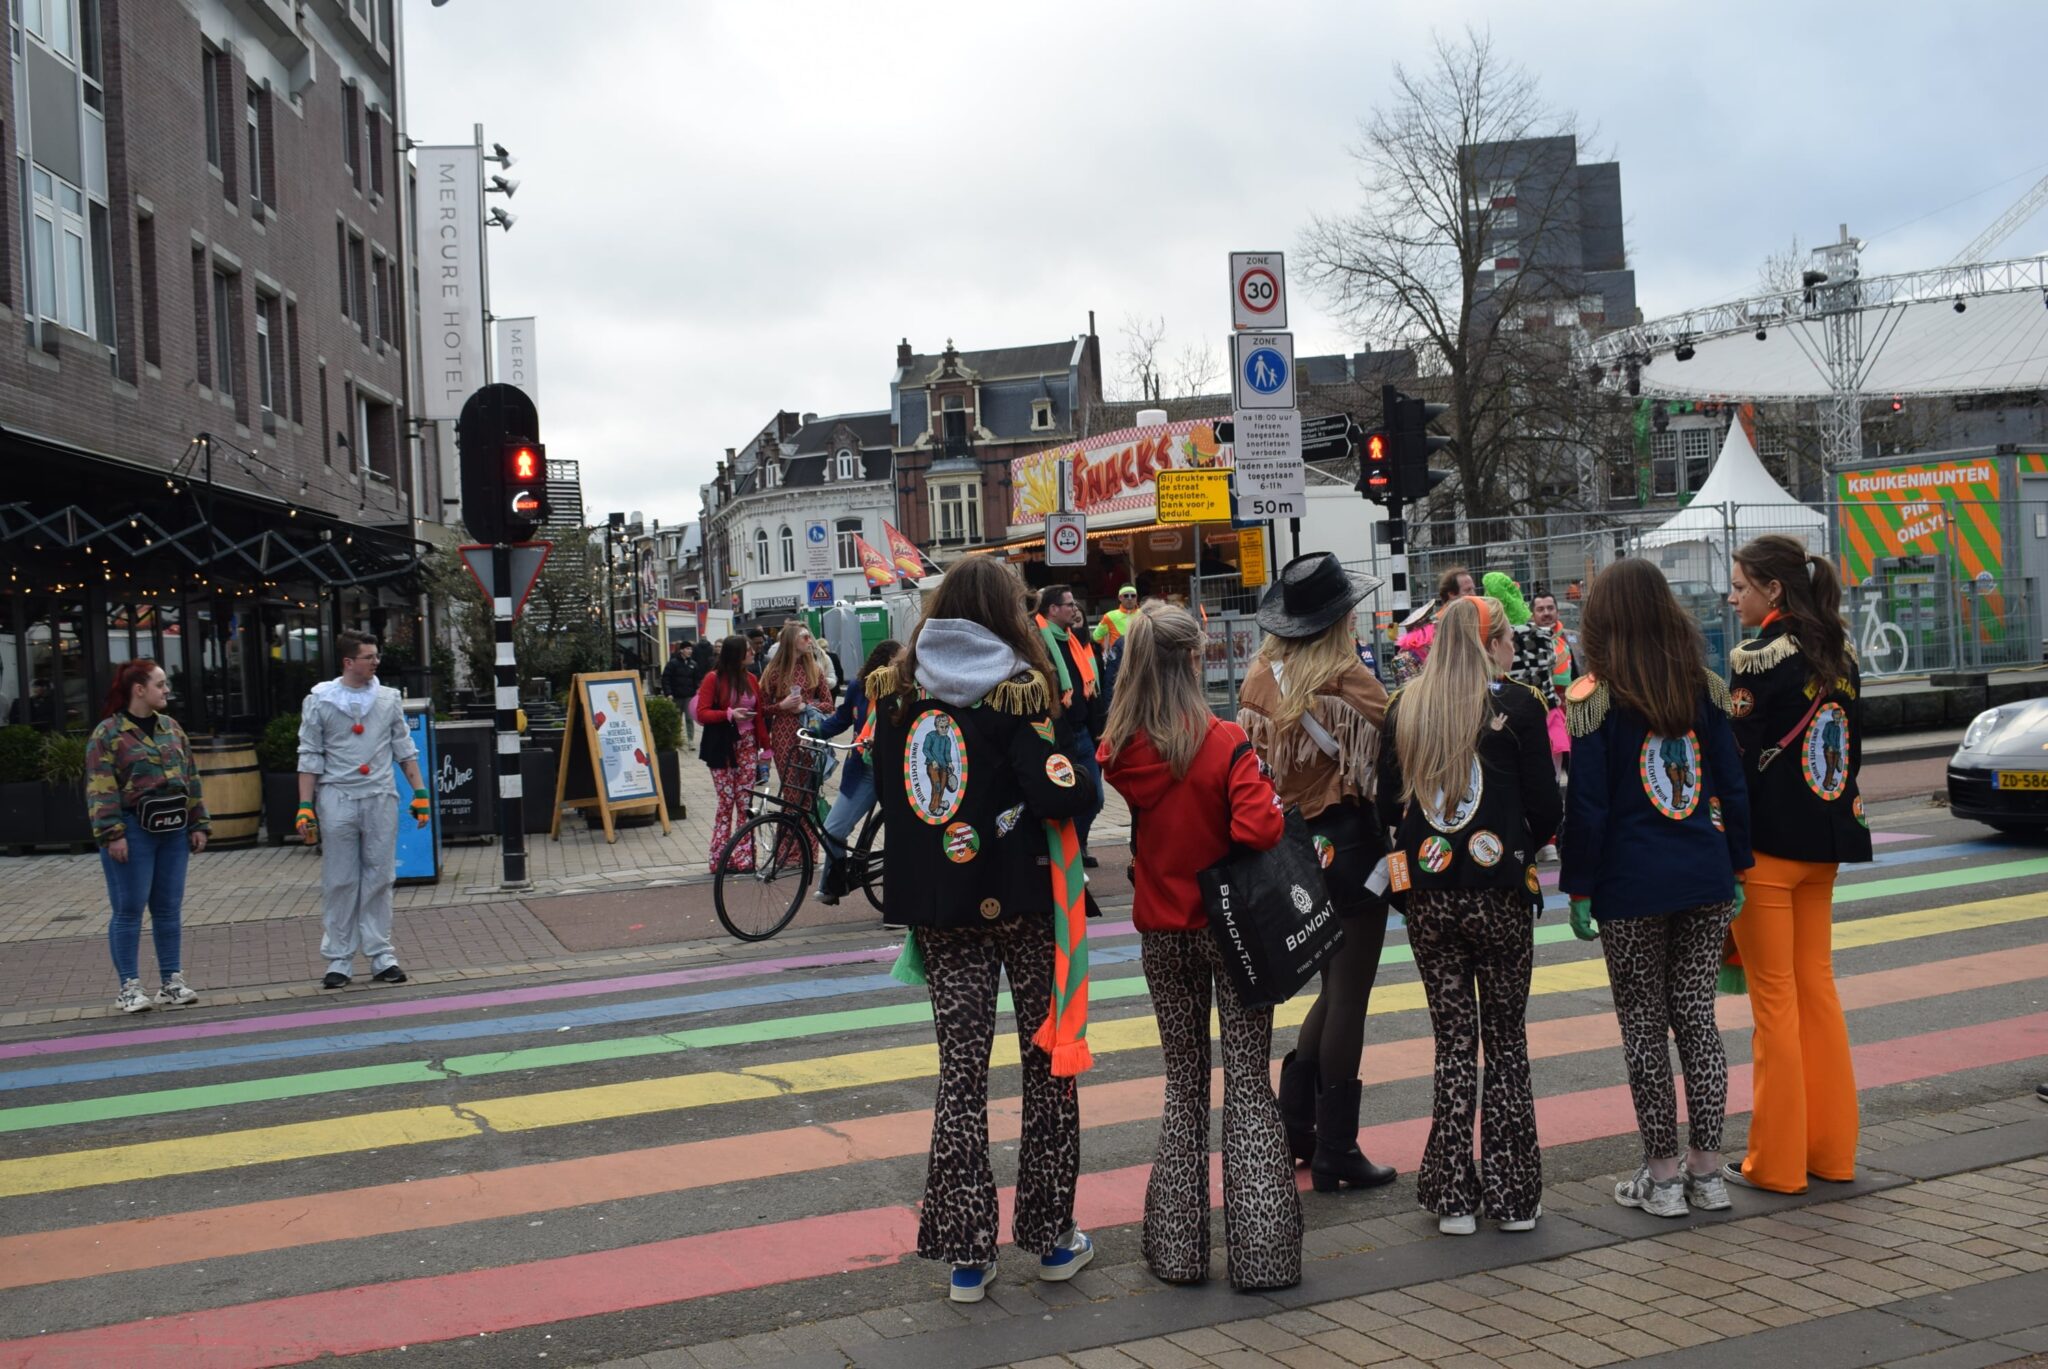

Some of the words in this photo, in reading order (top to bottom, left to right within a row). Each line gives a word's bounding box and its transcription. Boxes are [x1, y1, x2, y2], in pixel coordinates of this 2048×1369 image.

[440, 163, 459, 298] MERCURE
[1246, 257, 1269, 265] ZONE
[1247, 281, 1273, 299] 30
[1253, 337, 1278, 345] ZONE
[444, 311, 463, 401] HOTEL
[1247, 432, 1290, 440] toegestaan
[1072, 432, 1173, 511] SNACKS
[1161, 475, 1173, 483] Bij
[1248, 472, 1294, 481] toegestaan
[1848, 467, 1990, 494] KRUIKENMUNTEN
[1207, 501, 1215, 509] je
[1902, 498, 1929, 521] PIN
[1897, 514, 1945, 543] ONLY!
[770, 597, 796, 608] LADAGE
[911, 760, 919, 783] ECHTE
[1648, 765, 1657, 785] ECHTE
[914, 783, 927, 805] KRUIK
[155, 815, 182, 827] FILA
[1220, 884, 1258, 984] BOMONT.NL
